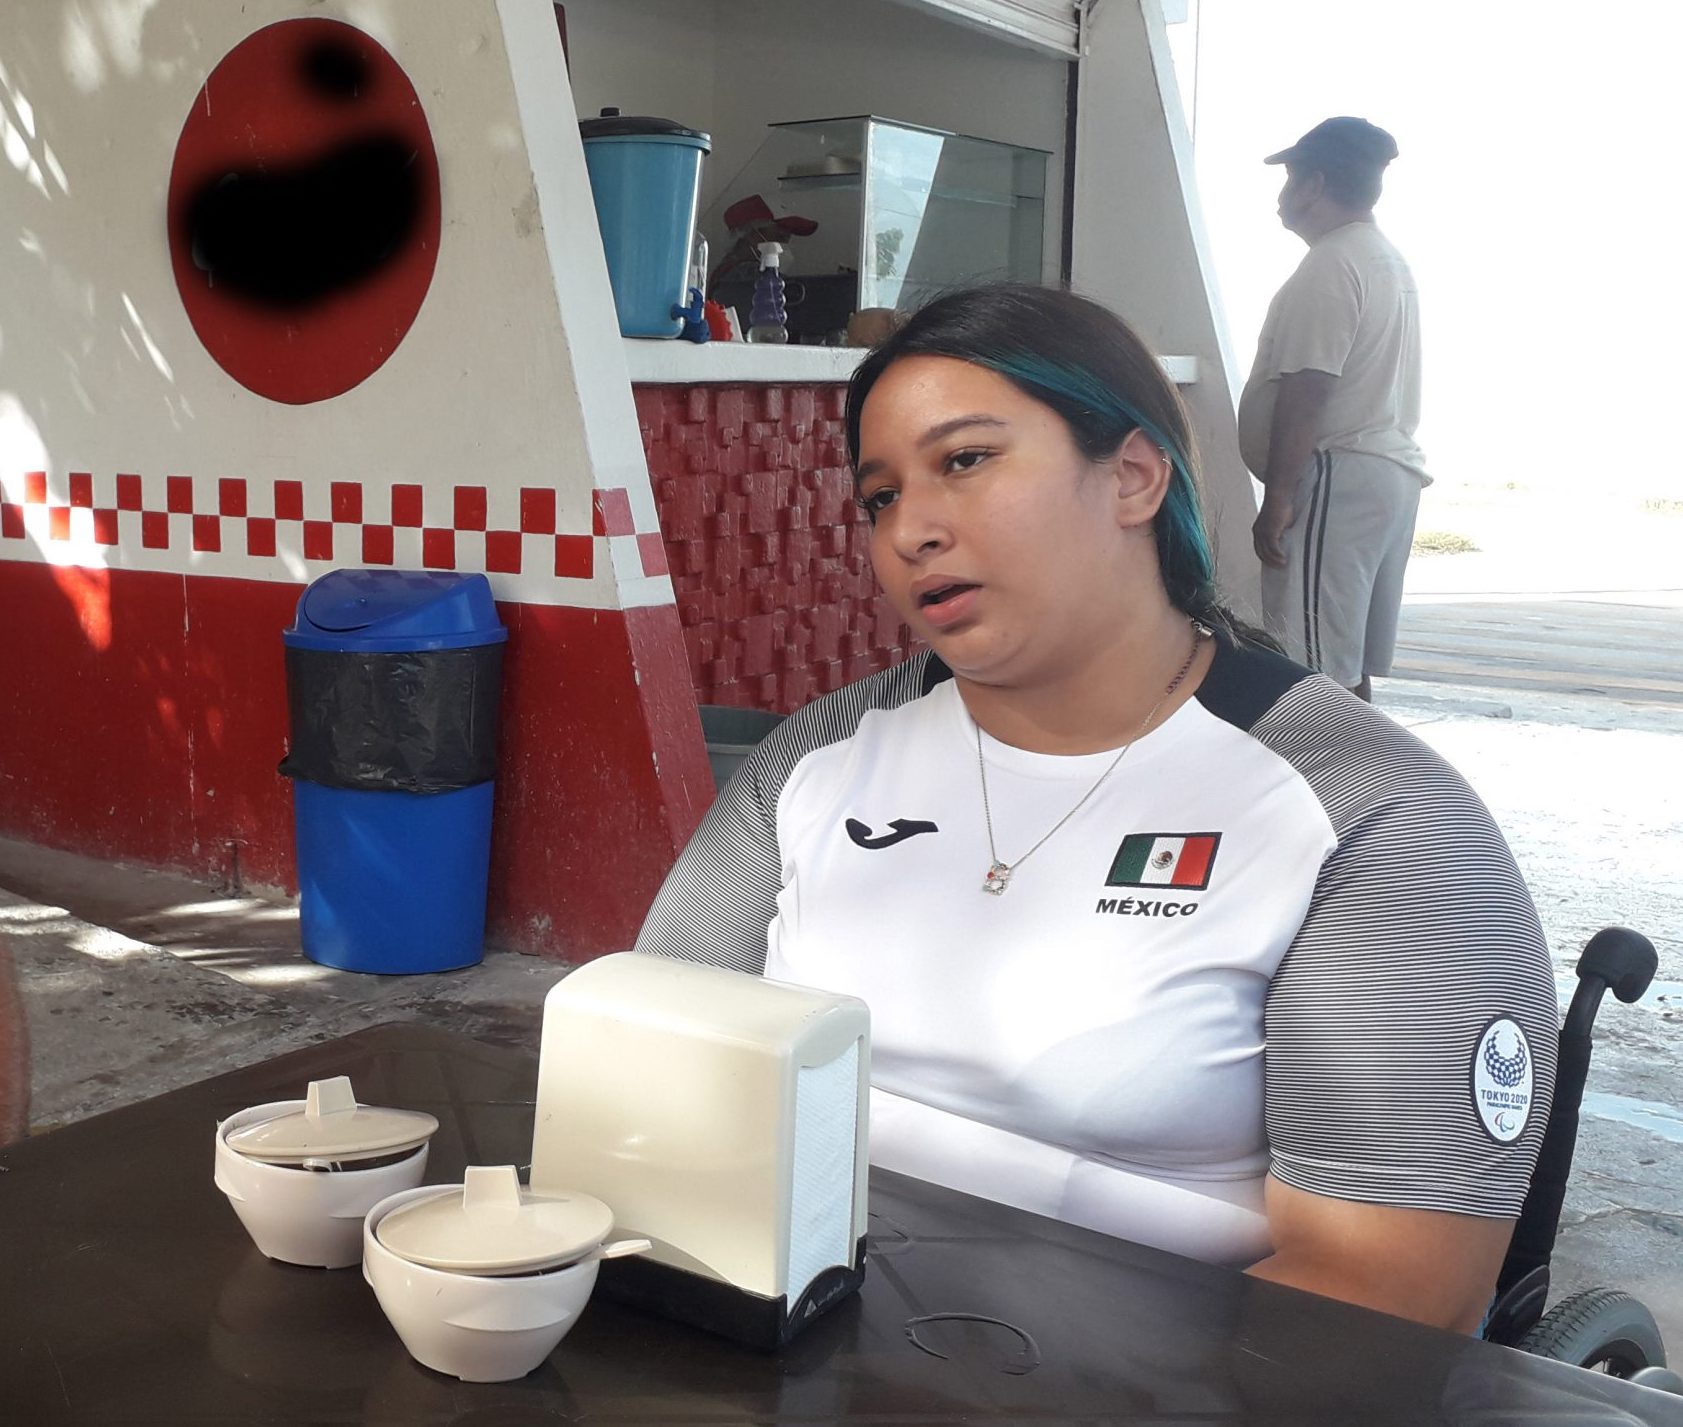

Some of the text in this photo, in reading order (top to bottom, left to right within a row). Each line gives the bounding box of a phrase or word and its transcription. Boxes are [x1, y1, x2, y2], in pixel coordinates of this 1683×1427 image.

[1095, 896, 1199, 918] MÉXICO
[1480, 1089, 1528, 1105] TOKYO 2020
